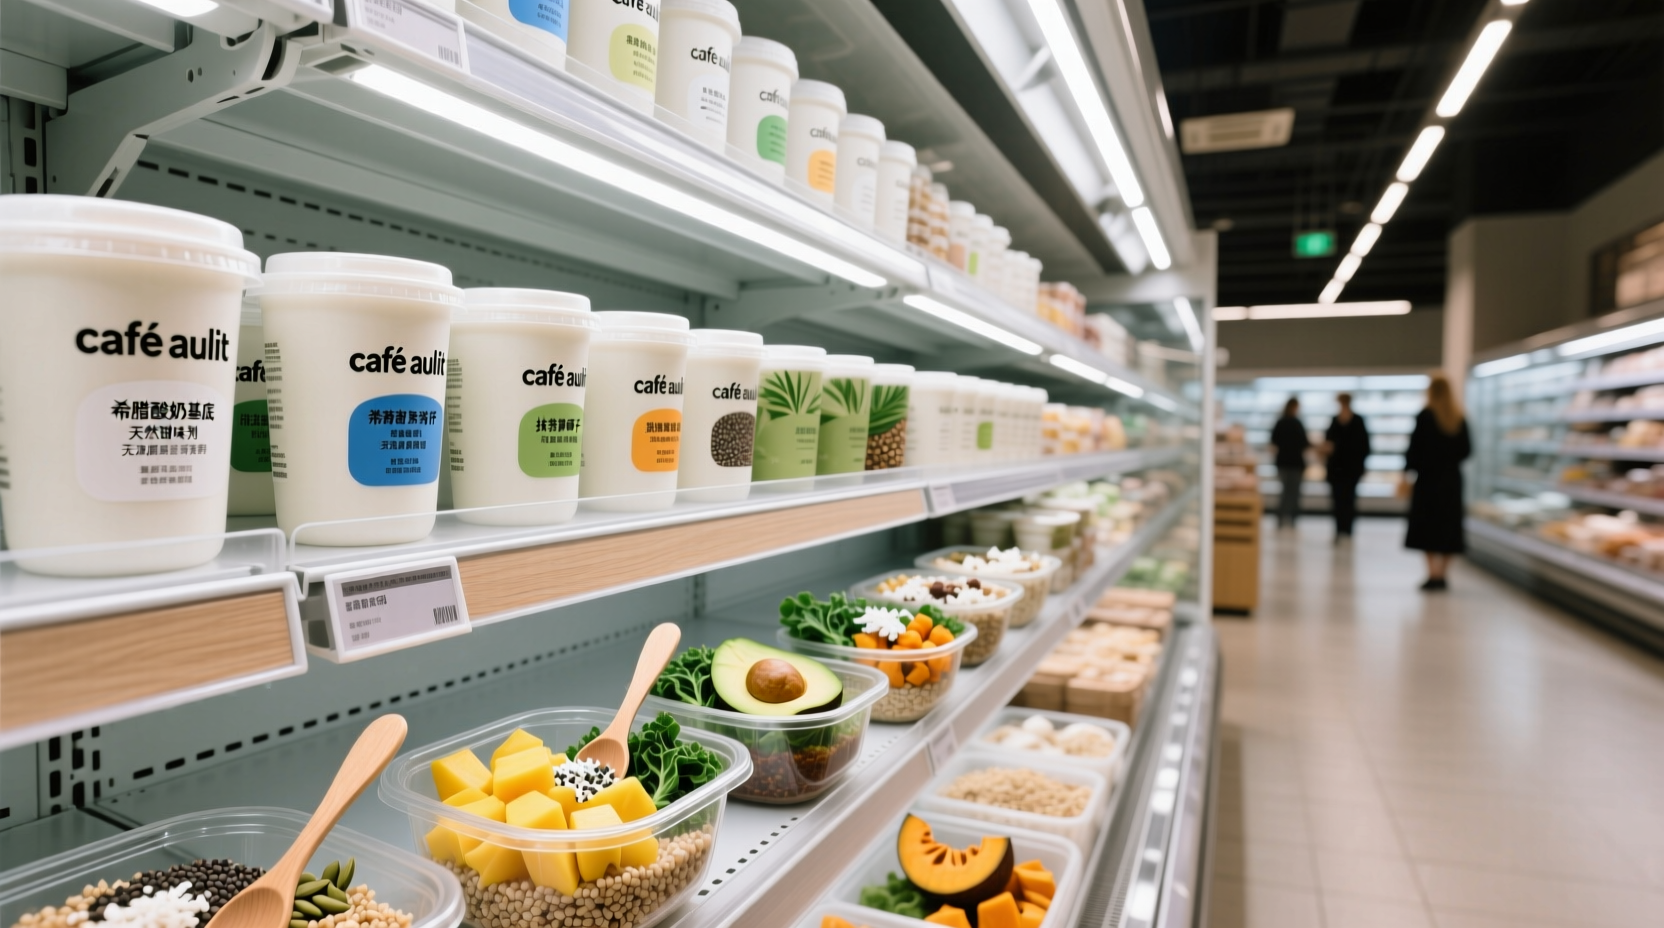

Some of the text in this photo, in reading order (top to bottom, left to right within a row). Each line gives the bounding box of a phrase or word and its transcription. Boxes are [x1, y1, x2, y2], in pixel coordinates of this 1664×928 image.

[76, 320, 229, 361] café aulit
[349, 346, 407, 374] café
[522, 363, 565, 386] café
[634, 375, 667, 394] café
[712, 382, 741, 400] café
